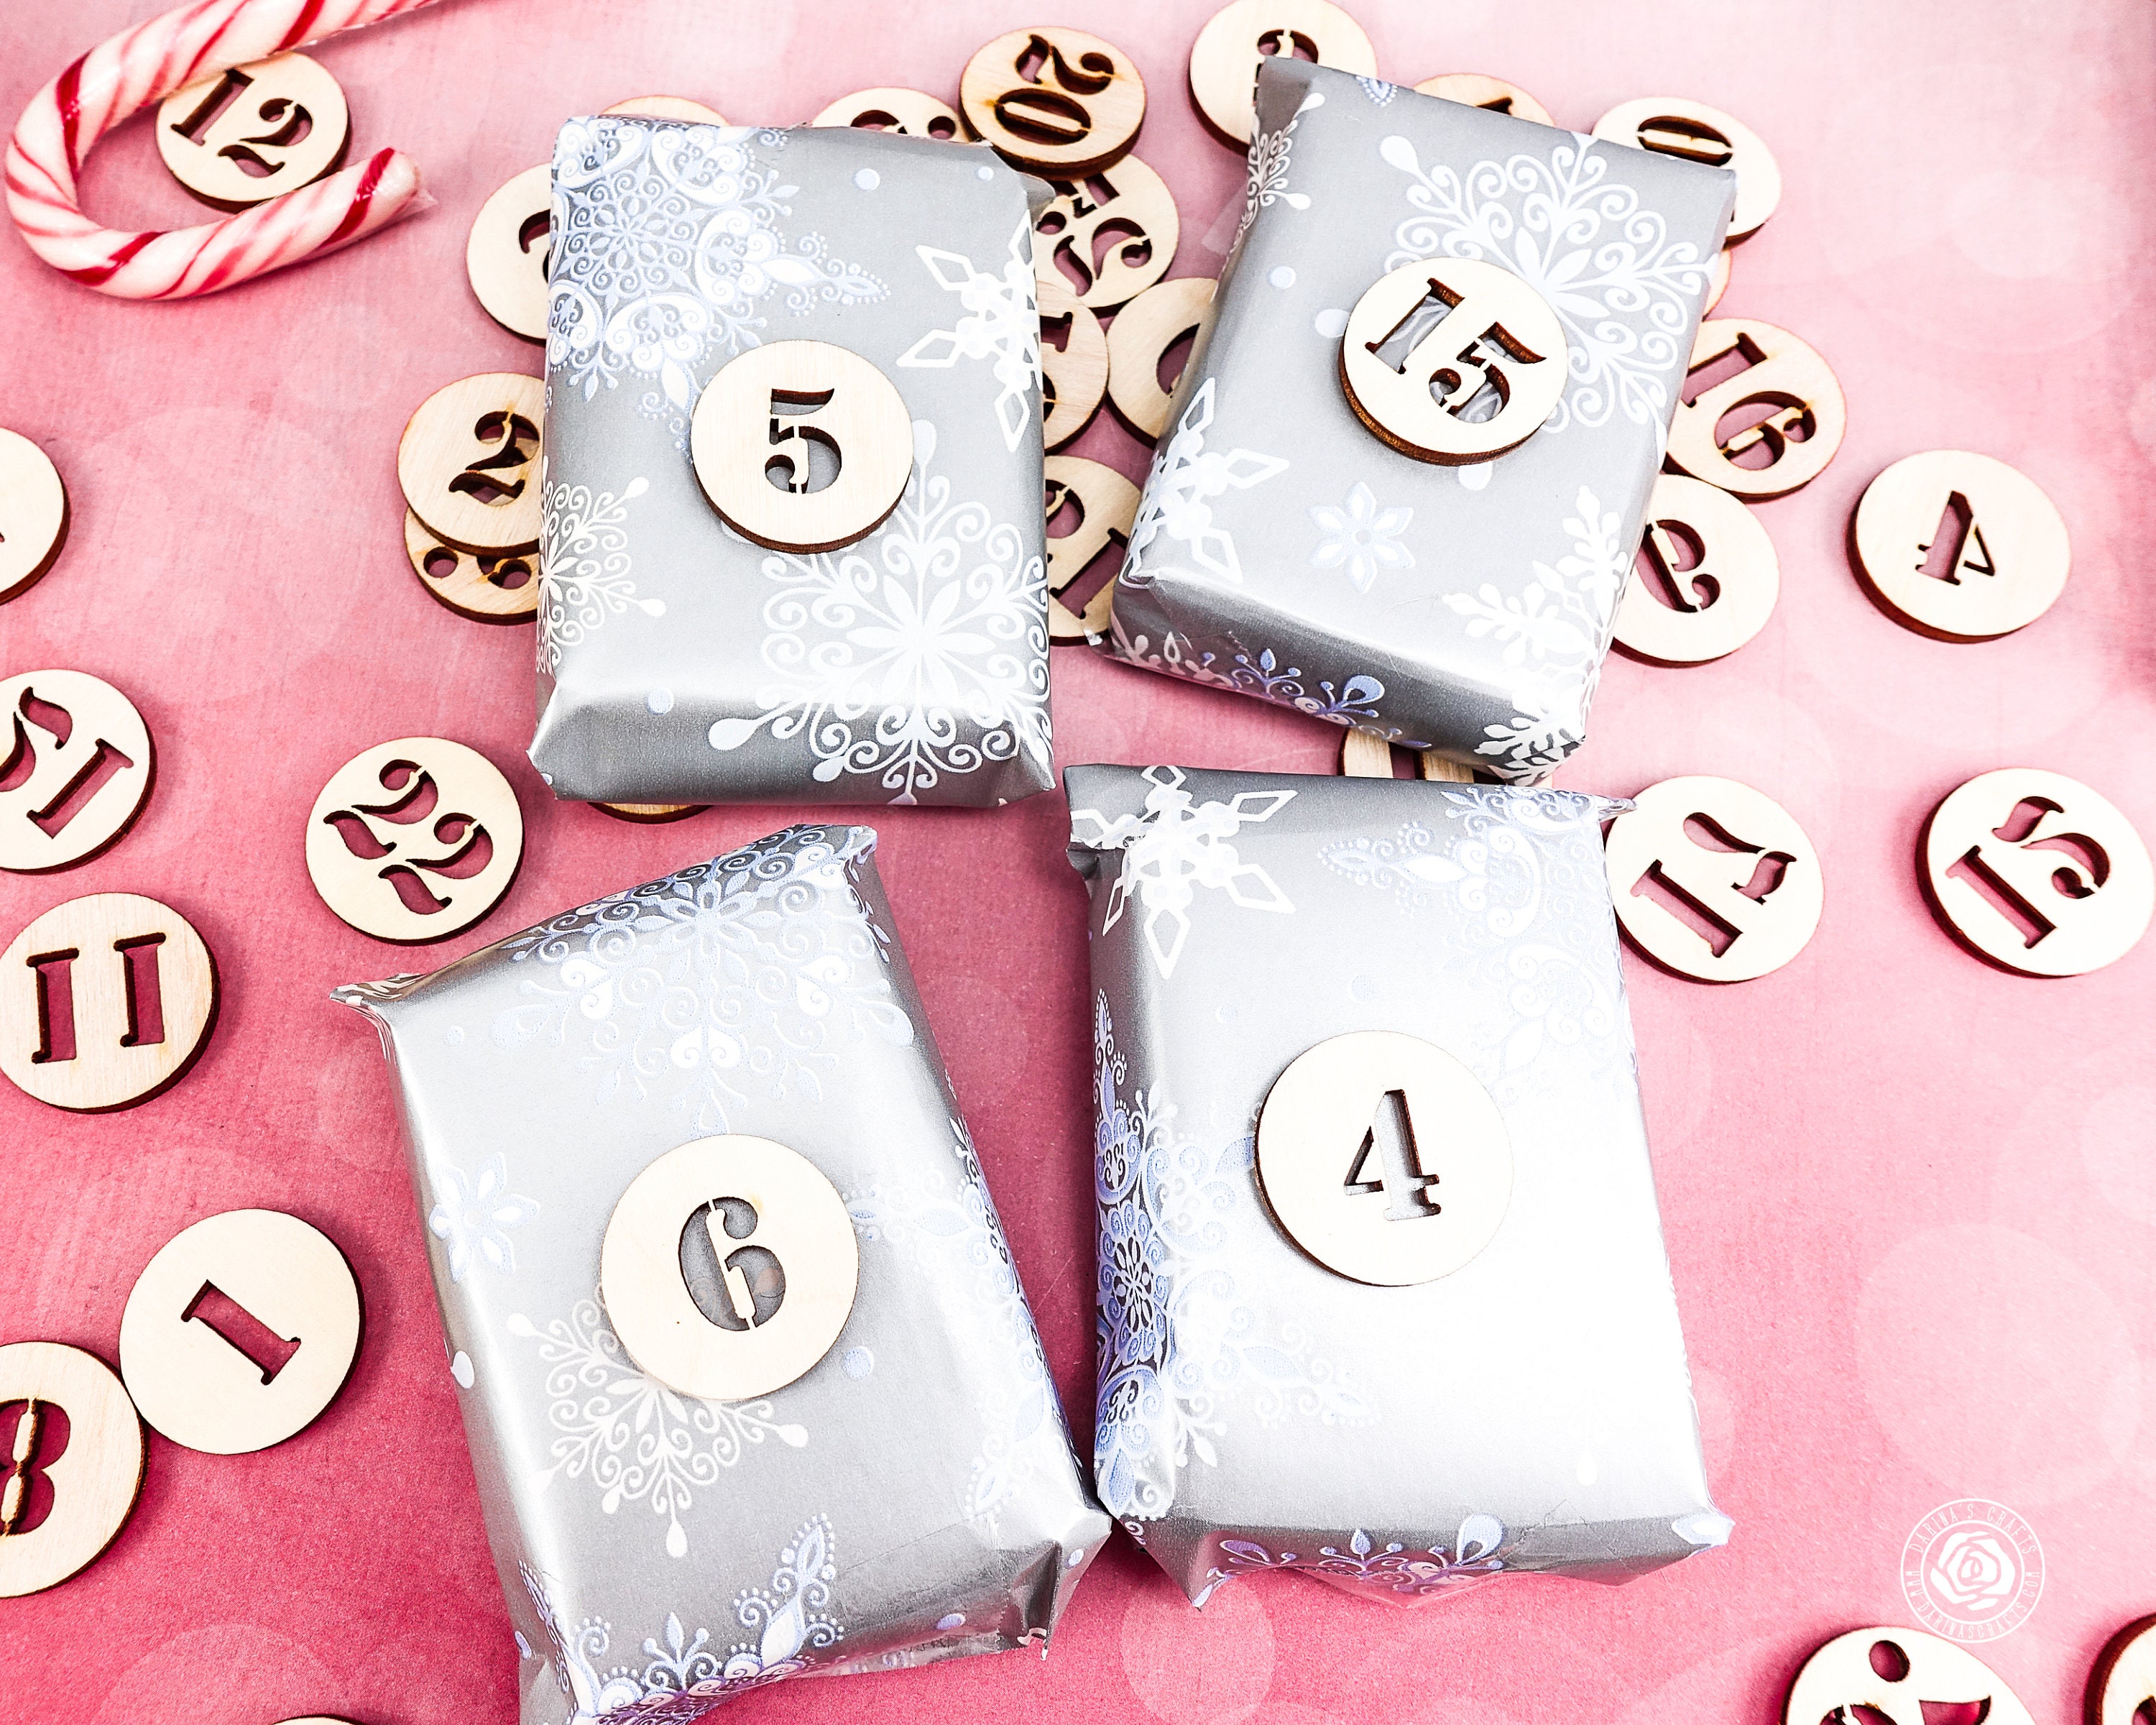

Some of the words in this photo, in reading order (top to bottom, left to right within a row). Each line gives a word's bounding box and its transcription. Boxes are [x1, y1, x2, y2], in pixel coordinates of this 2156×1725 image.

[170, 68, 313, 178] 12
[995, 34, 1115, 144] 20
[1365, 277, 1547, 423] 15
[1680, 331, 1817, 471] 16
[448, 410, 540, 507] 2
[765, 388, 842, 494] 5
[323, 760, 494, 914] 22
[26, 932, 166, 1064] 11
[1343, 1089, 1442, 1221] 4
[678, 1197, 786, 1331] 6
[180, 1279, 301, 1386] 1
